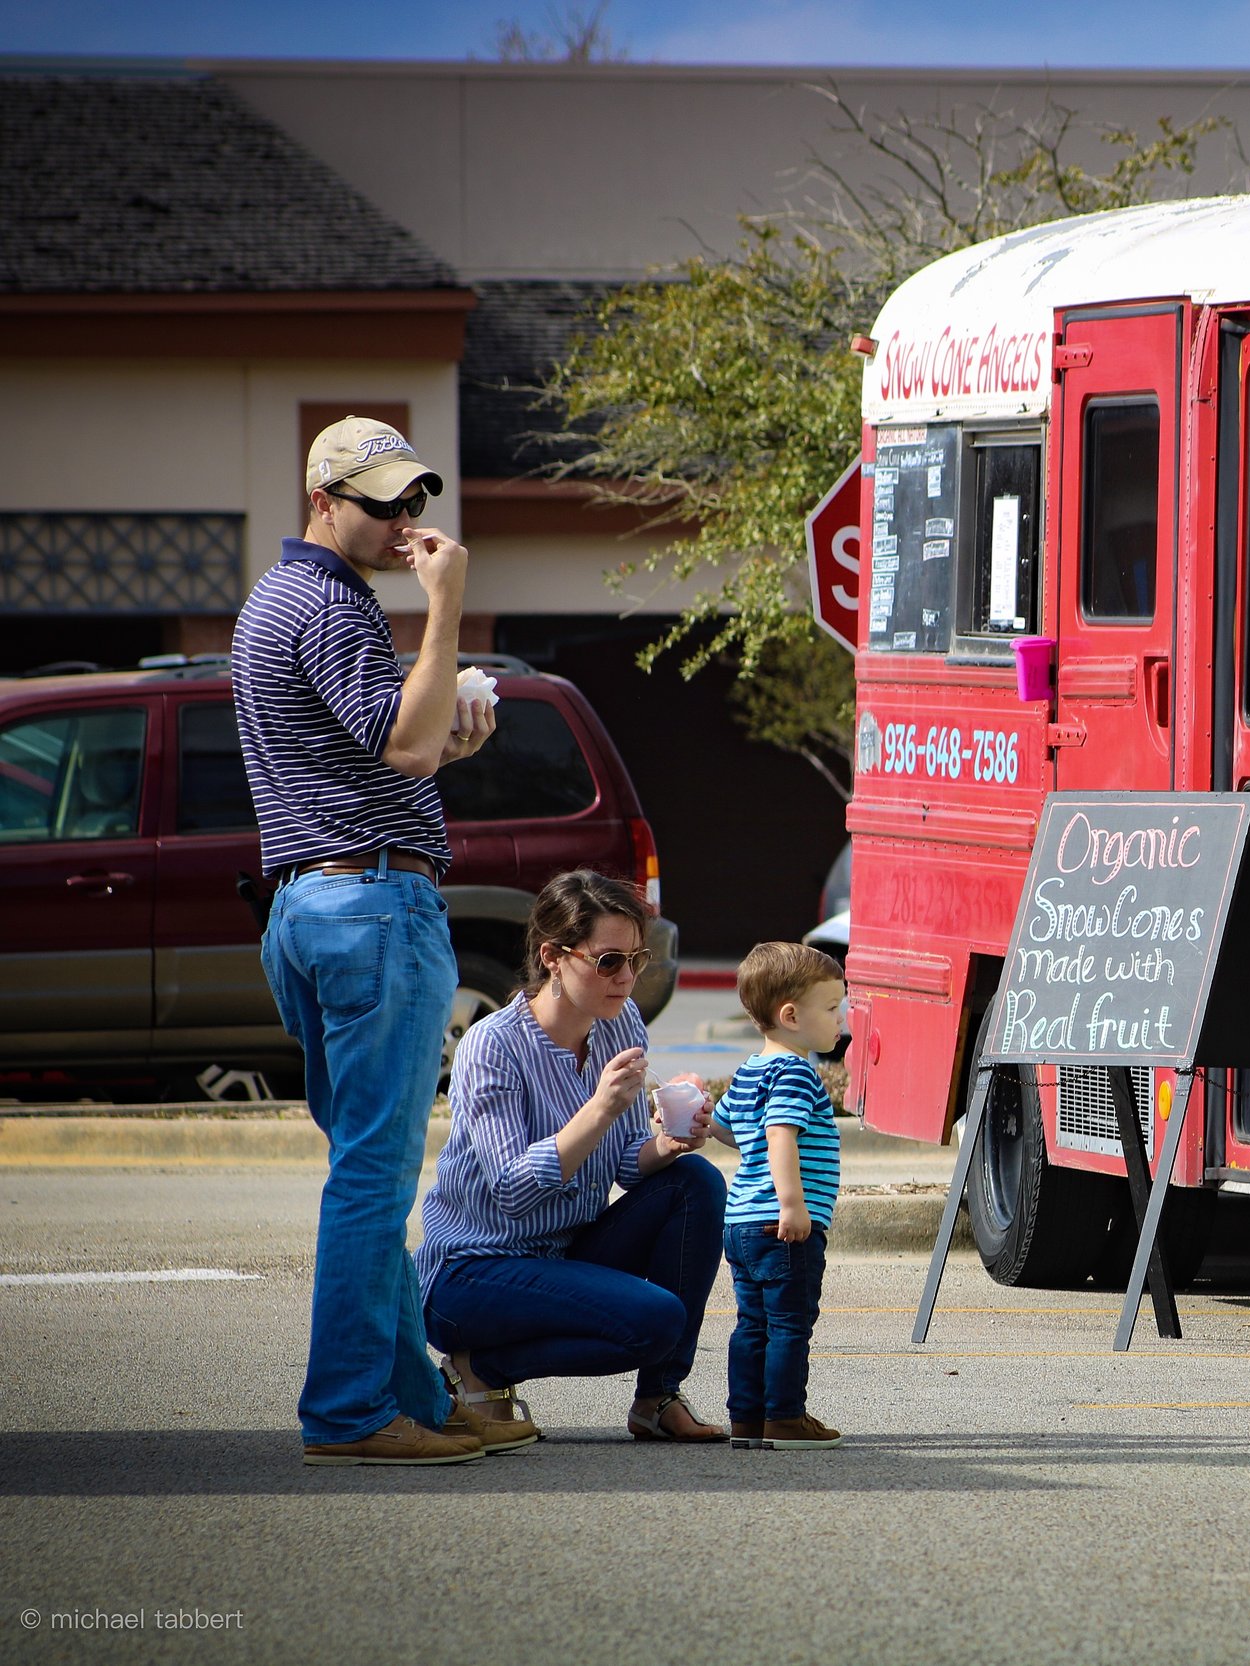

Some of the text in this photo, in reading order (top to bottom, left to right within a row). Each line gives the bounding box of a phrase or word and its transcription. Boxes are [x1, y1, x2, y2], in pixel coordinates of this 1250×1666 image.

[880, 322, 1047, 401] SNOW CONE ANGELS
[884, 722, 1018, 784] 936-648-7586
[1056, 812, 1201, 885] Organic
[1018, 944, 1175, 986] made with
[1001, 989, 1175, 1055] Real fruit
